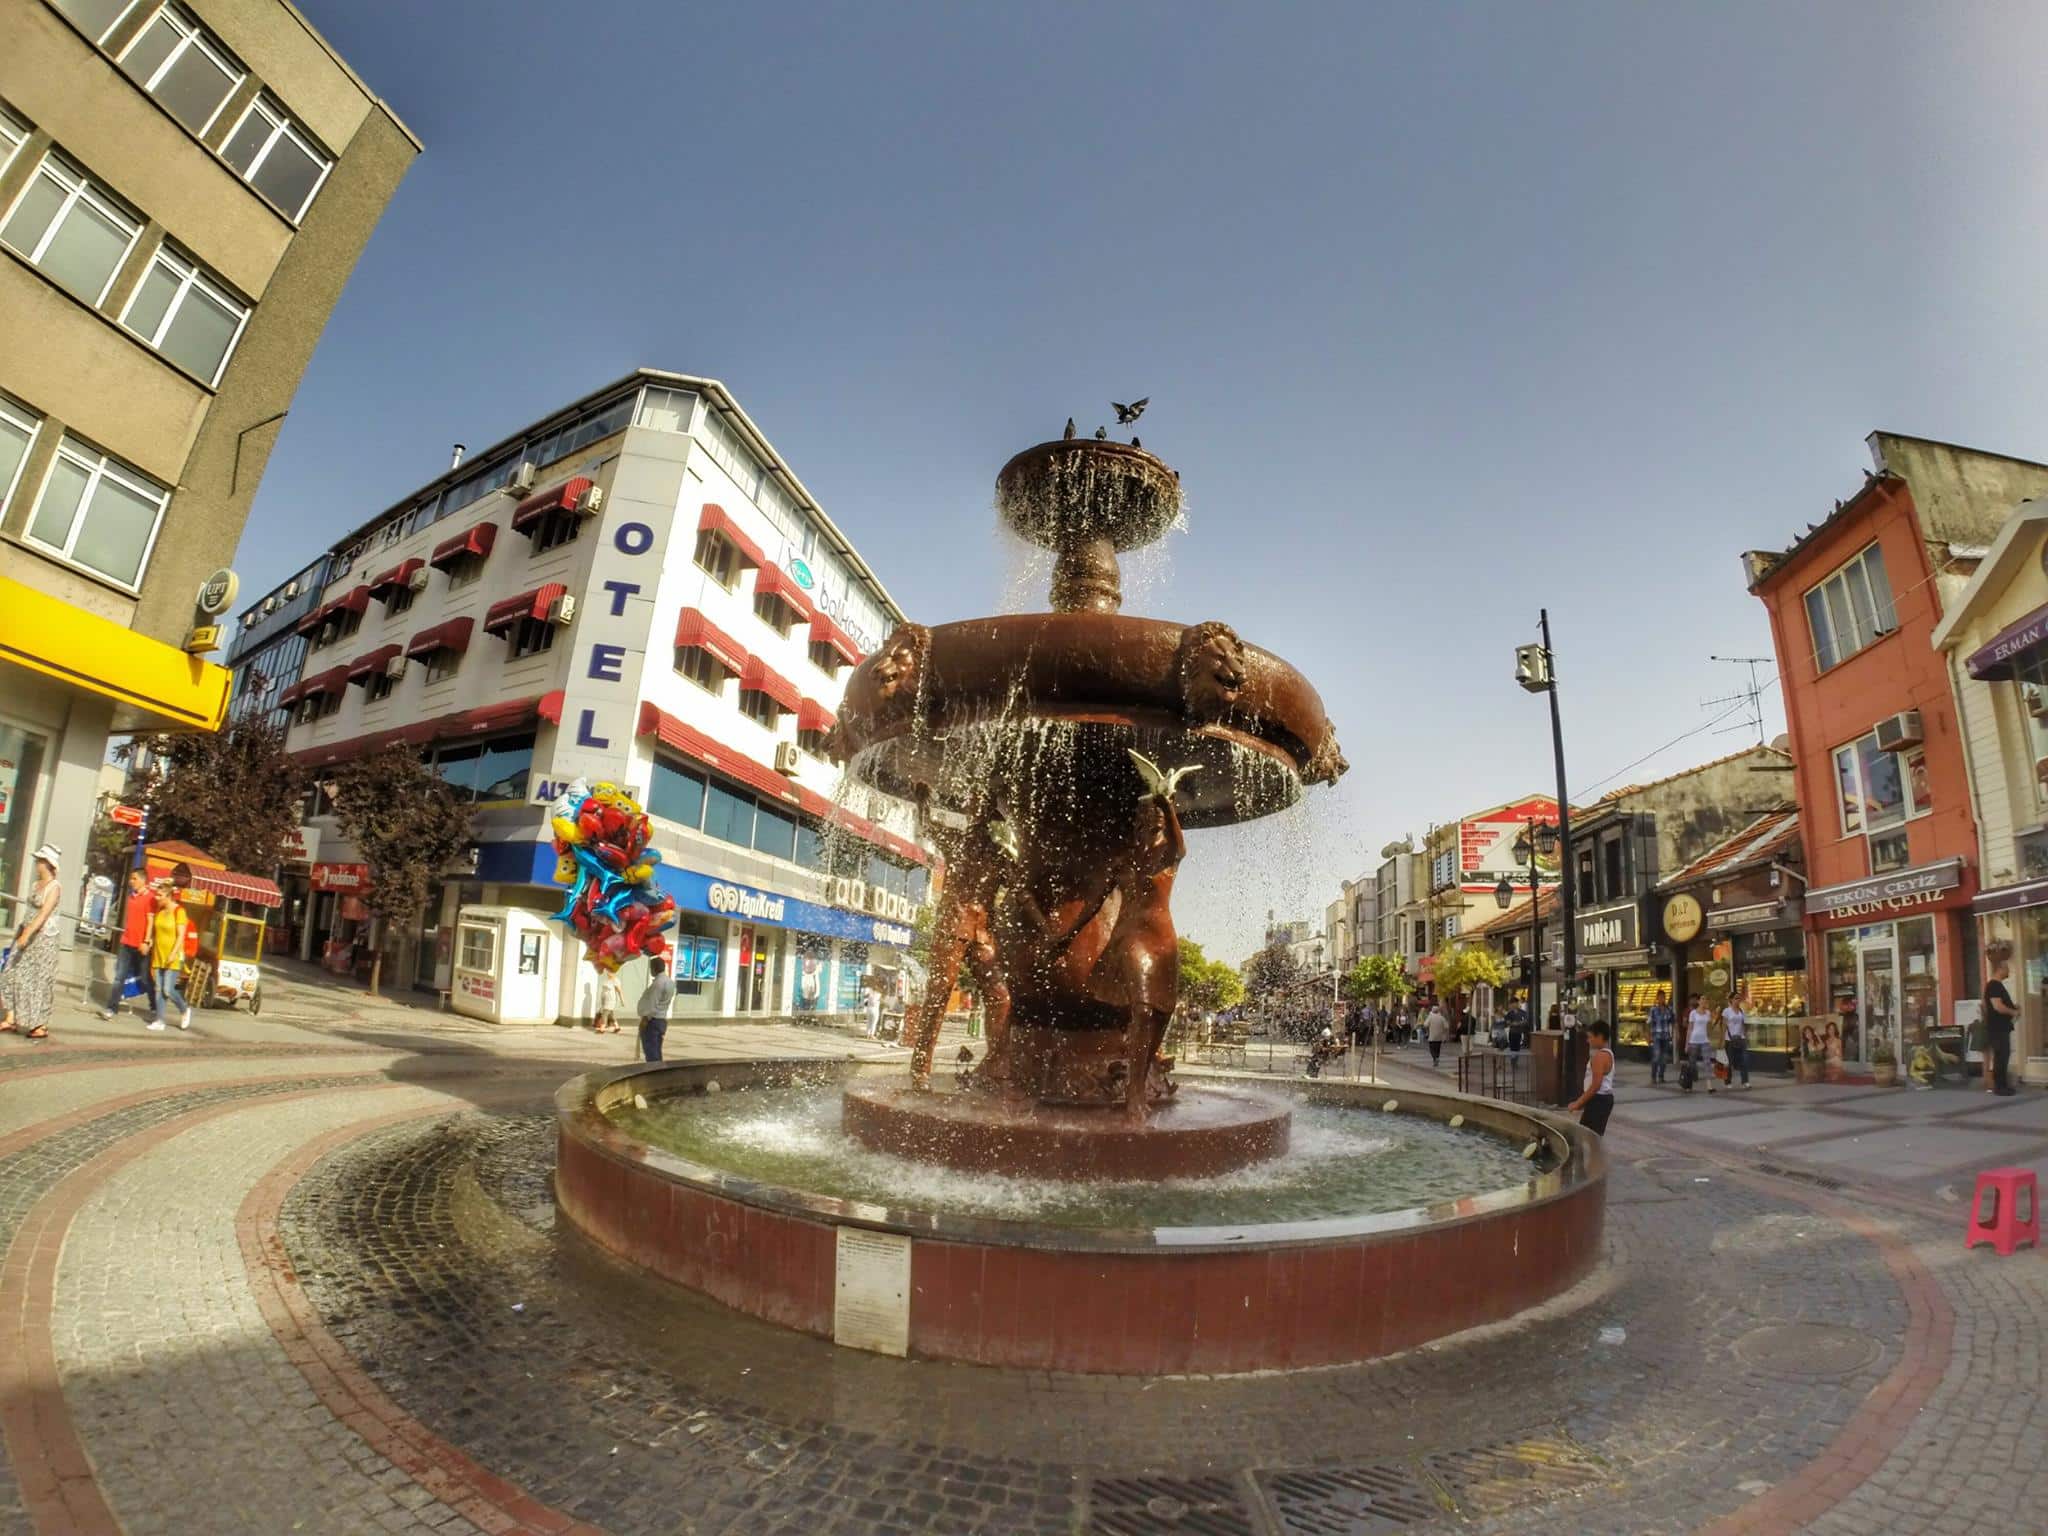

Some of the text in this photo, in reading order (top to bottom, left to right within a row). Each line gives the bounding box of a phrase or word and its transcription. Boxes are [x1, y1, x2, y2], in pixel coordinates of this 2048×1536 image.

[576, 522, 654, 749] OTEL
[1994, 626, 2040, 660] ERMAN
[1824, 873, 1937, 906] TEKÜN ÇEYİZ
